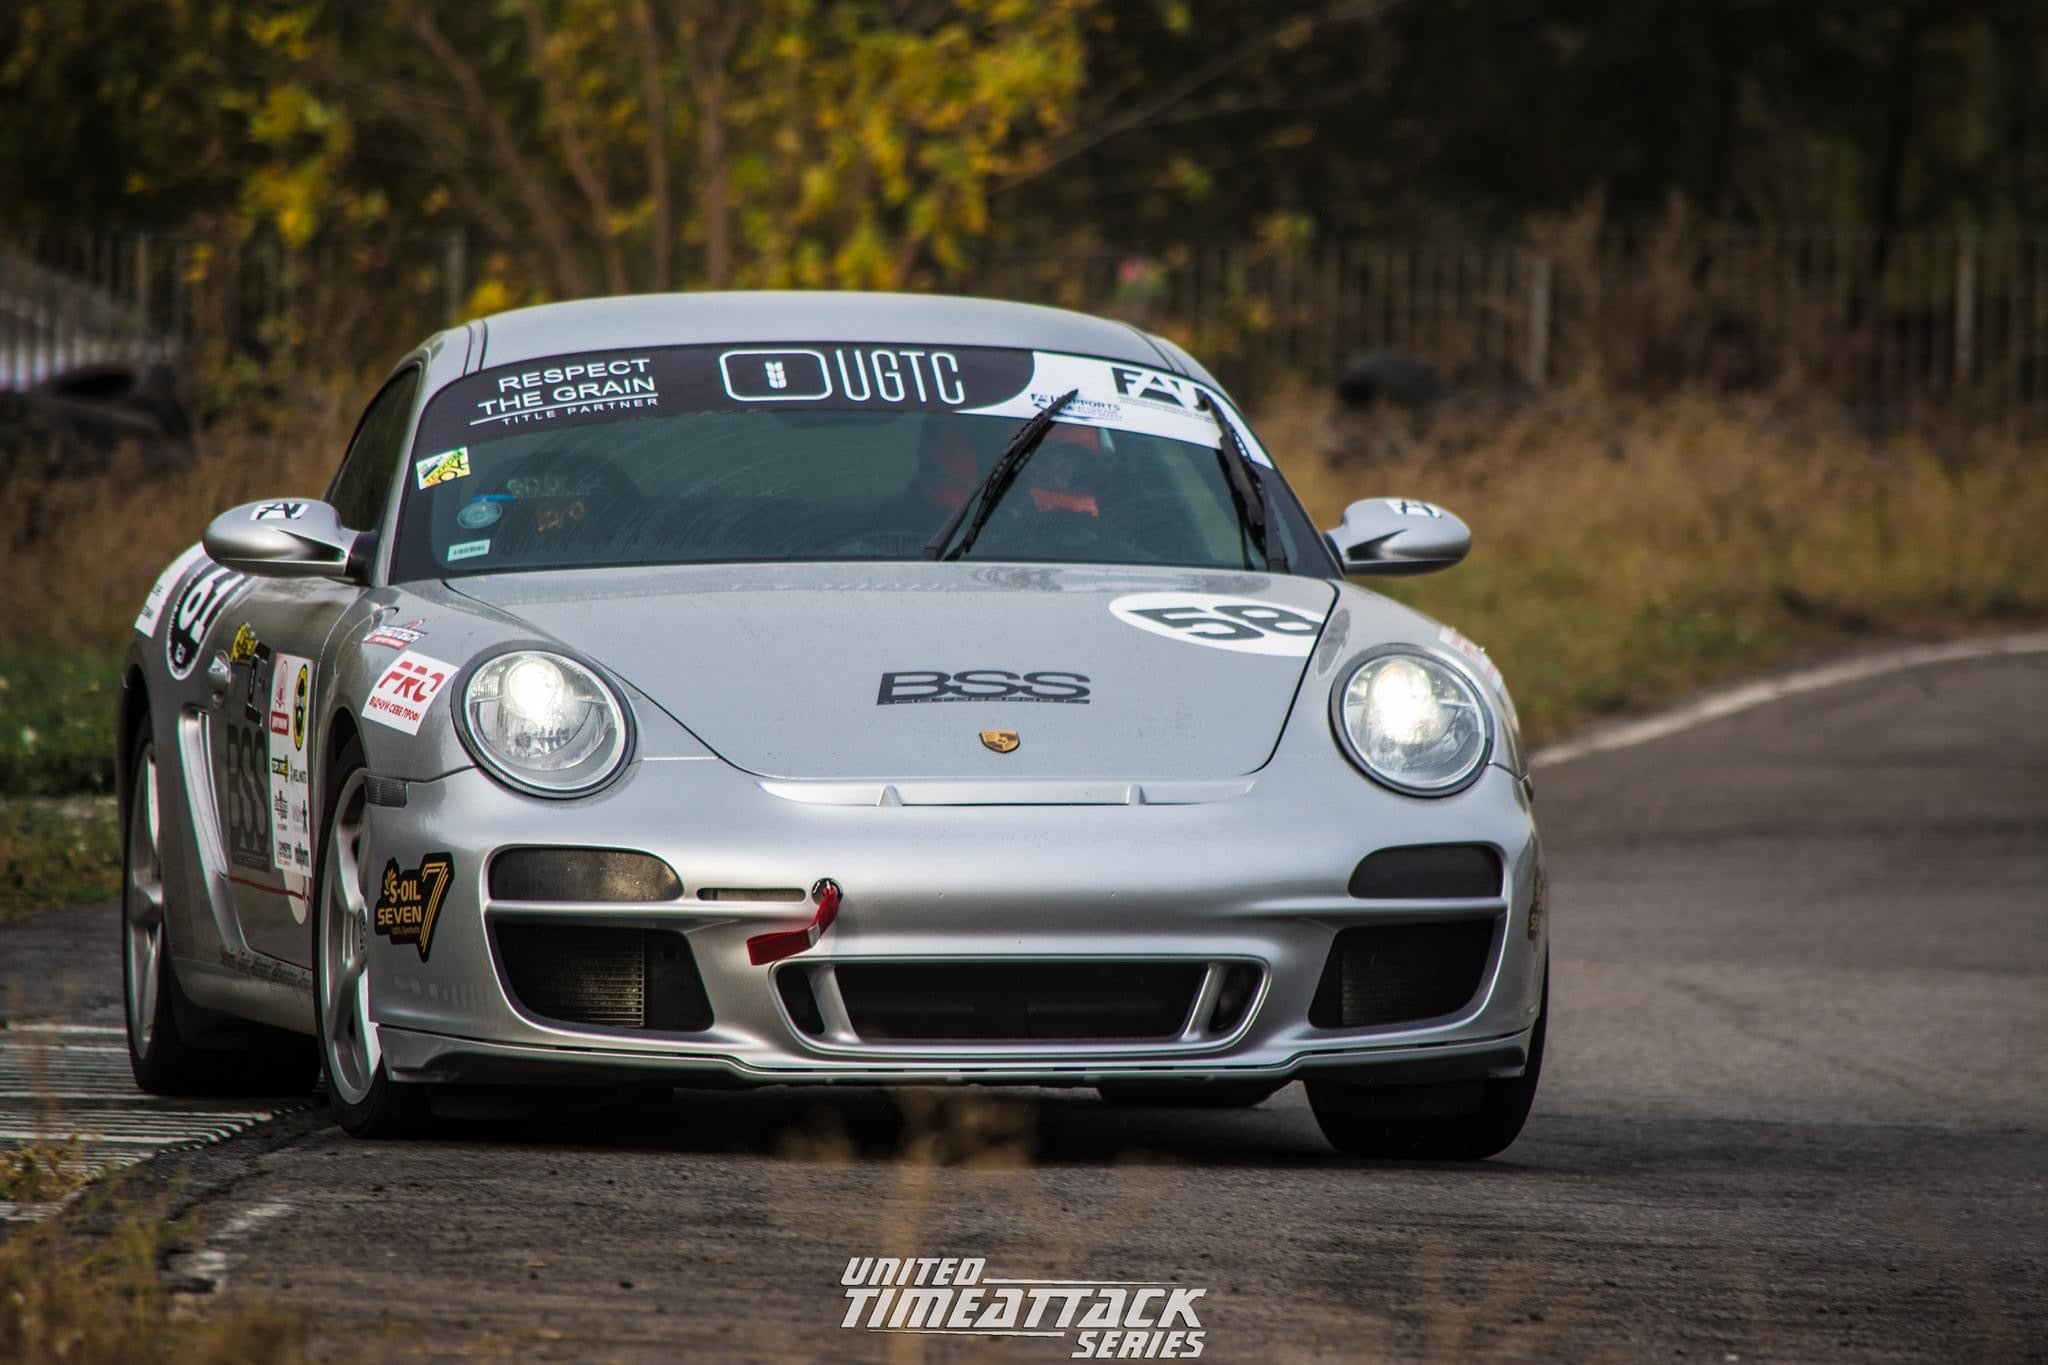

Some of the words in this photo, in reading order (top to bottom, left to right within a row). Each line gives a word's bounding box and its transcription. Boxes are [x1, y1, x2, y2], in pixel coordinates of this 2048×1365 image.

[499, 358, 650, 393] RESPECT
[836, 350, 965, 405] UGTC
[478, 391, 544, 416] THE
[552, 377, 656, 401] GRAIN
[501, 410, 557, 426] TITLE
[566, 398, 659, 416] PARTNER
[1126, 604, 1324, 641] 58
[378, 660, 445, 703] PRO
[876, 669, 1091, 706] BSS
[389, 879, 422, 903] S-OIL
[377, 905, 422, 926] SEVEN
